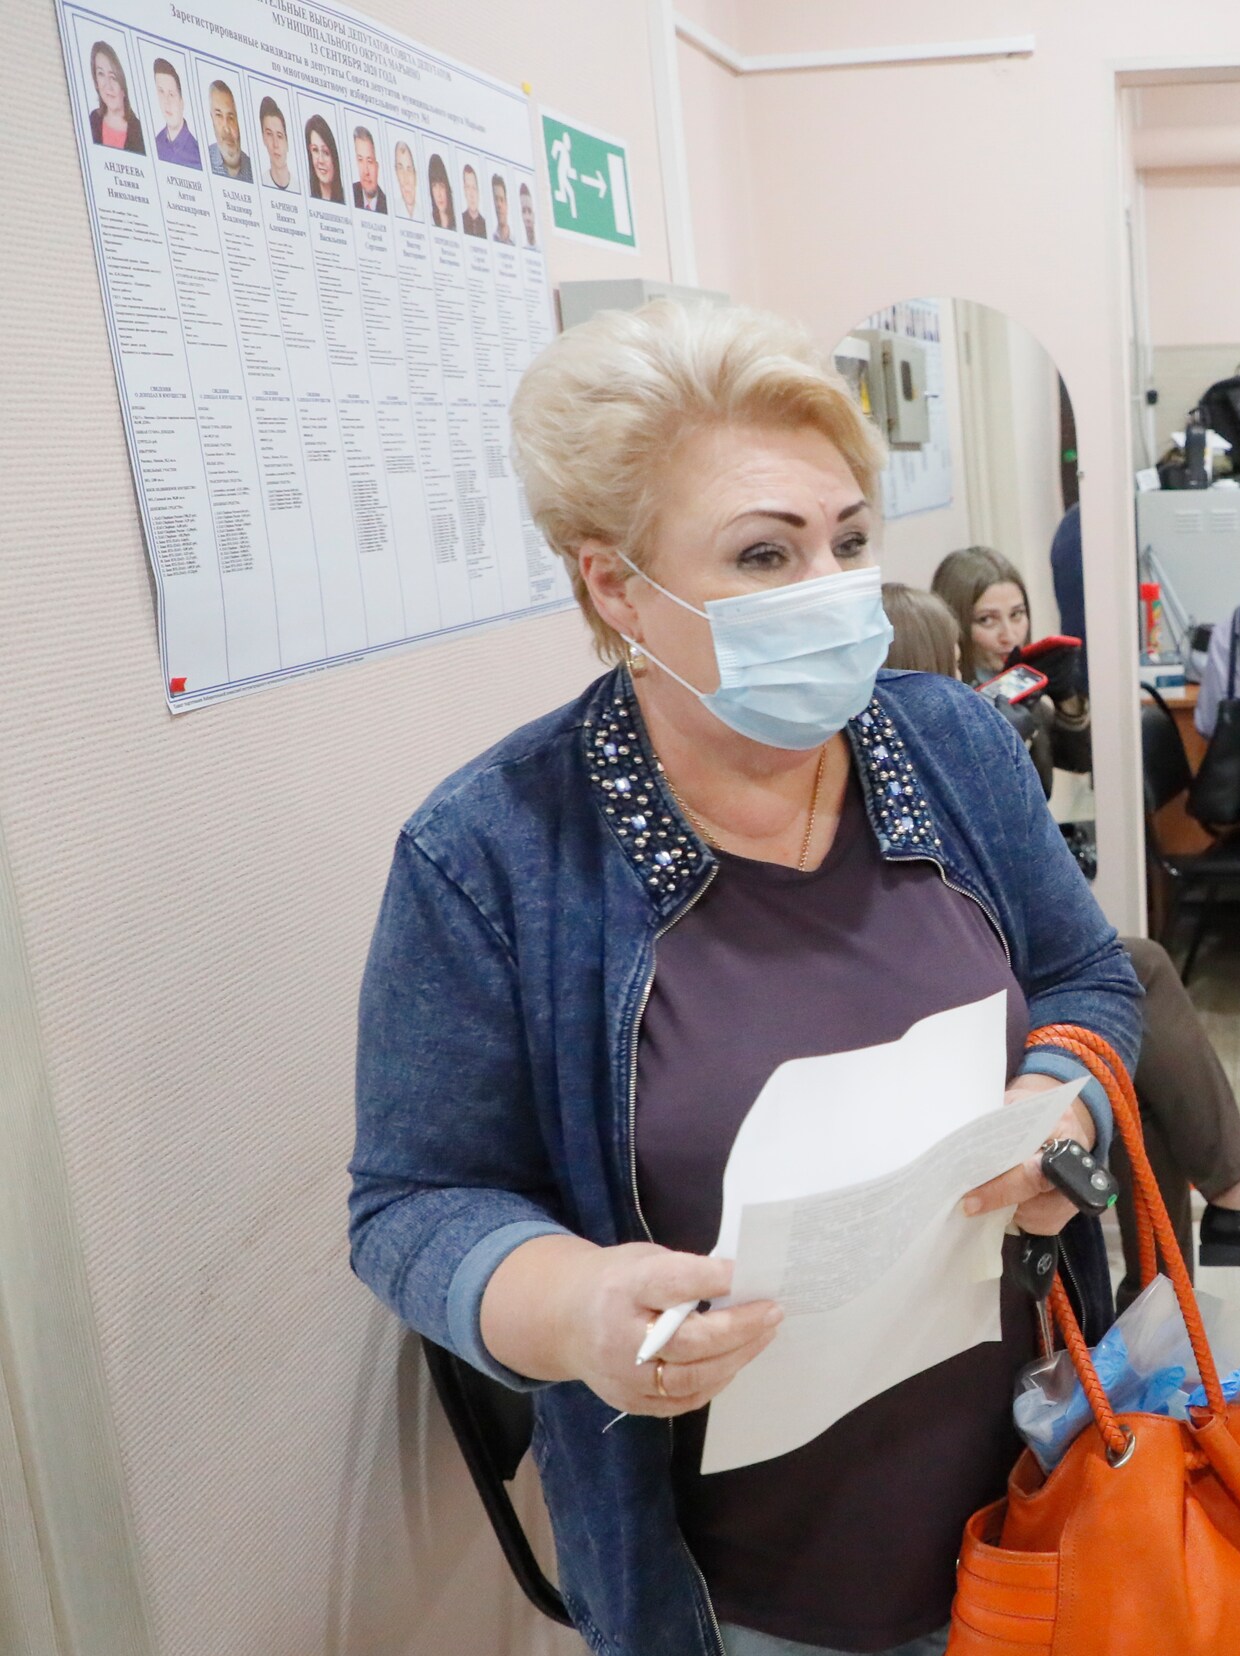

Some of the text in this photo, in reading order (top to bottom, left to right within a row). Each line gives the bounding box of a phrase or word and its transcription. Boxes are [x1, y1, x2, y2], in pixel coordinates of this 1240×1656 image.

[170, 3, 259, 49] Зарегистрированные
[260, 42, 302, 65] кандидаты
[311, 60, 344, 78] депутаты
[345, 70, 369, 88] Совета
[272, 12, 358, 54] МУНИЦИПАЛЬНОГО
[359, 46, 387, 67] ОКРУГА
[308, 11, 346, 35] ВЫБОРЫ
[347, 27, 390, 54] ДЕПУТАТОВ
[271, 62, 281, 72] по
[283, 66, 348, 98] многомандатному
[310, 42, 397, 85] 13 СЕНТЯБРЯ 2020 ГОДА
[104, 161, 145, 178] АНДРЕЕВА
[114, 176, 140, 189] Галина
[107, 188, 150, 204] Николаевна
[167, 201, 211, 217] Александрович
